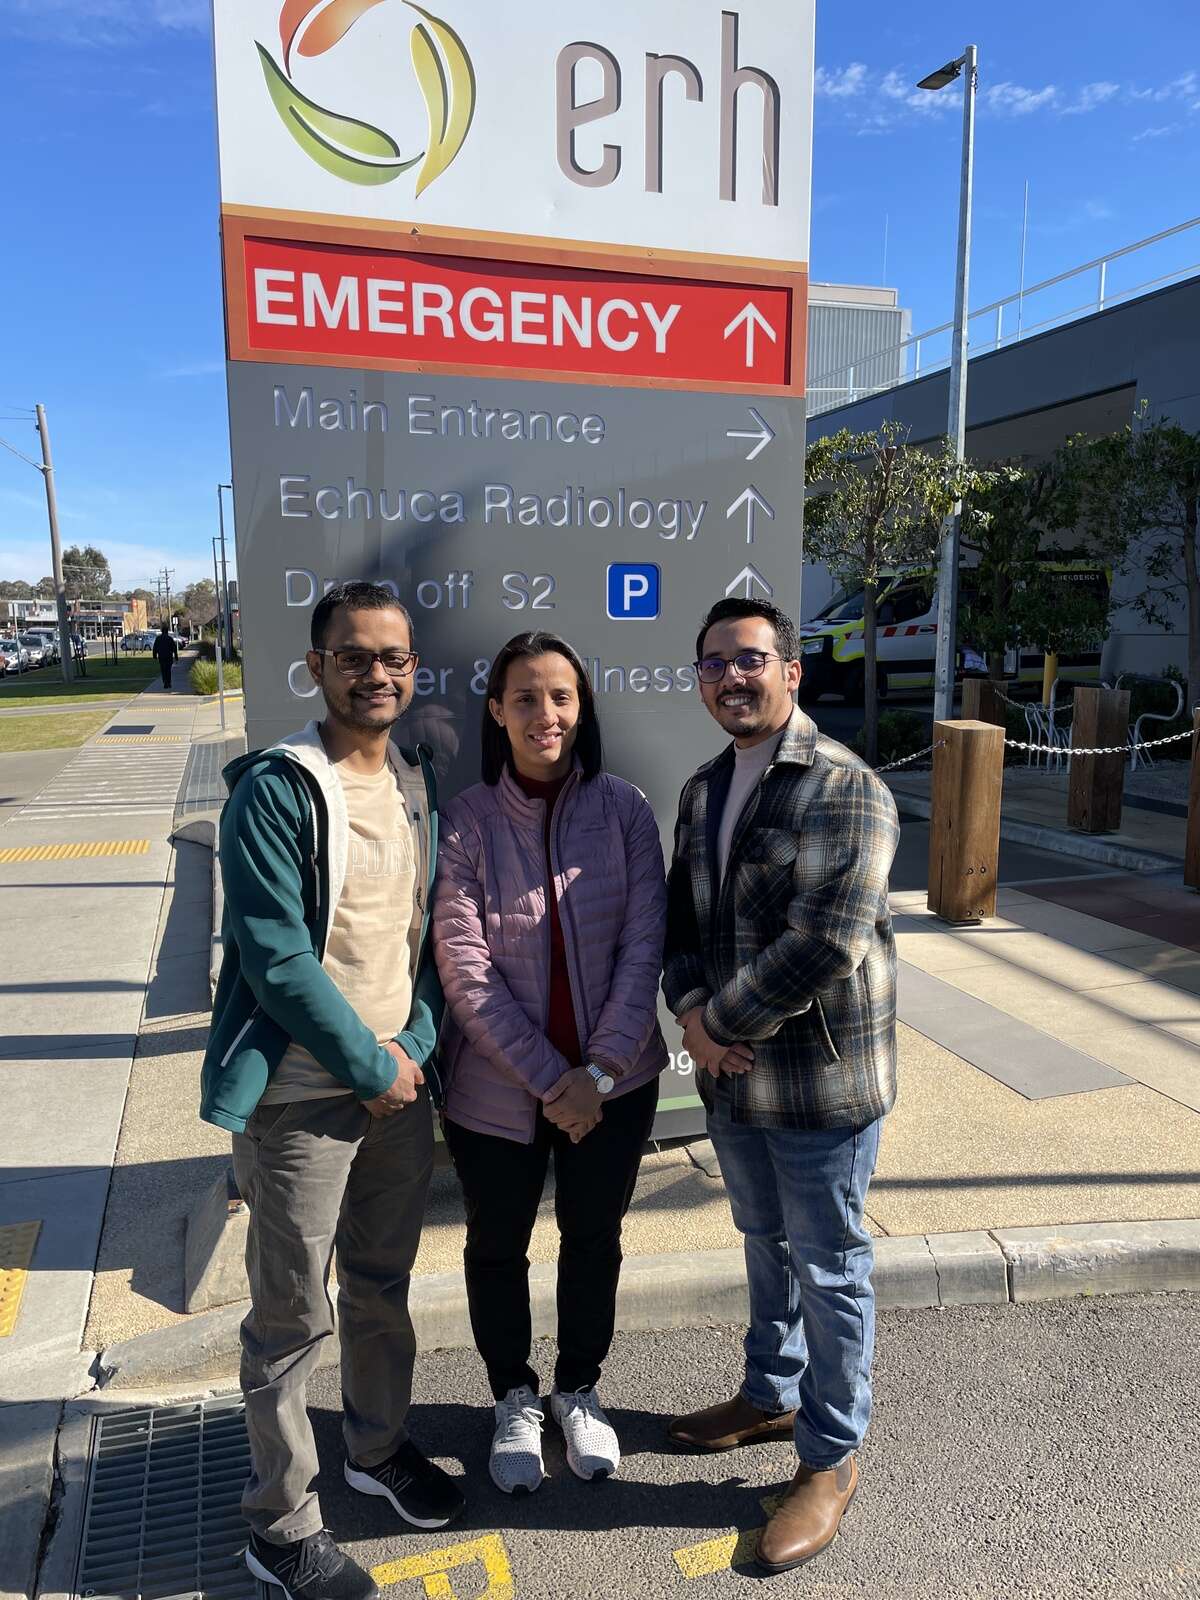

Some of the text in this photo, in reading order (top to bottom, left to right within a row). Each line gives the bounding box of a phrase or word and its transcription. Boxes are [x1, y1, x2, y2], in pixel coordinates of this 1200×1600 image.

[555, 10, 782, 207] erh
[253, 267, 682, 355] EMERGENCY
[272, 383, 607, 445] Main Entrance
[278, 473, 708, 542] Echuca Radiology
[416, 568, 475, 609] off
[500, 569, 557, 611] S2
[623, 573, 650, 611] P
[286, 659, 454, 698] Cer
[582, 656, 698, 693] lness
